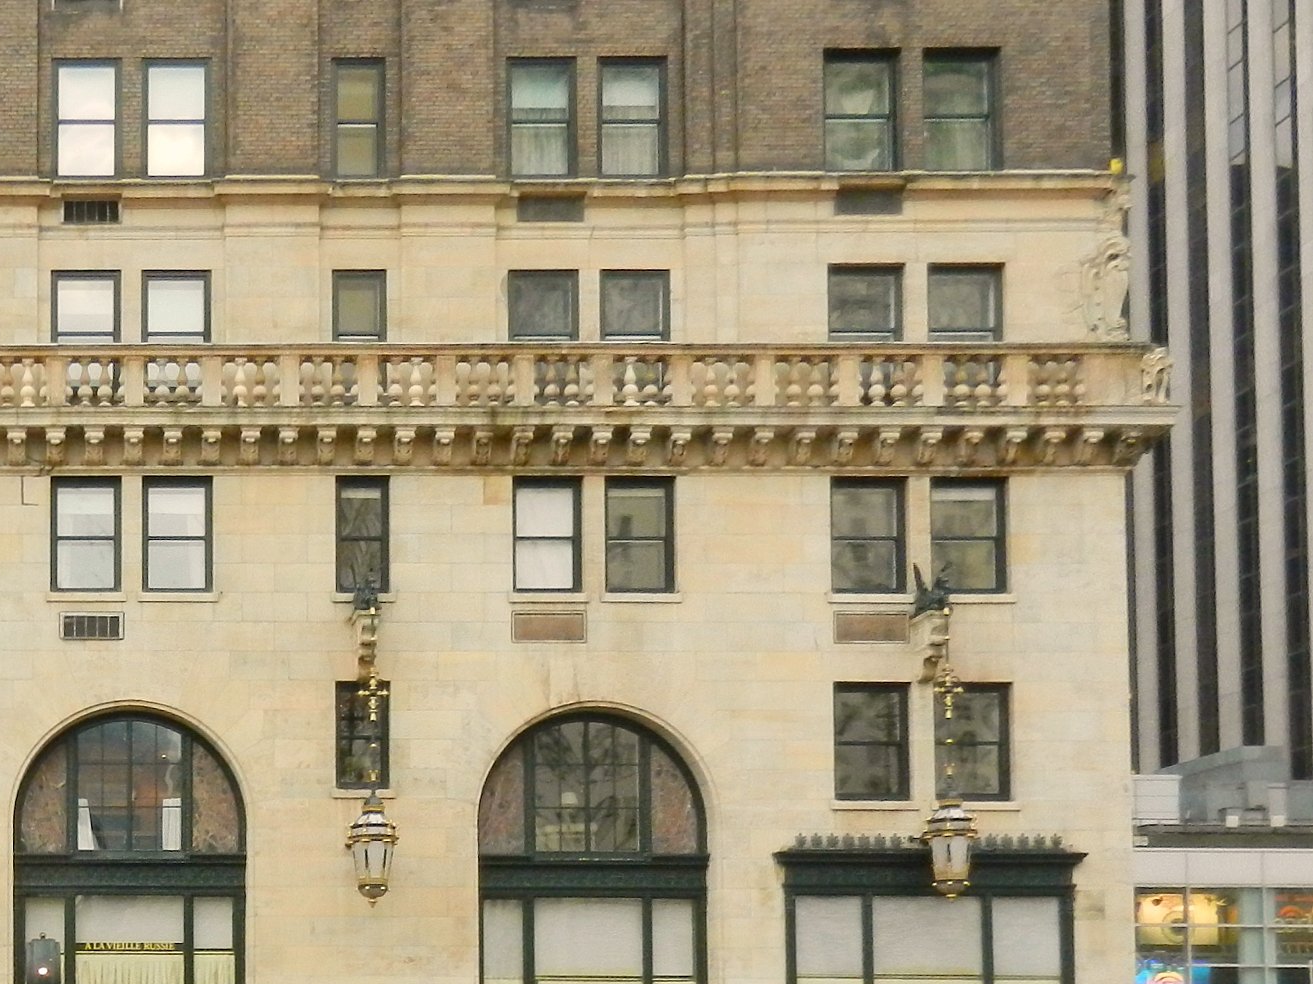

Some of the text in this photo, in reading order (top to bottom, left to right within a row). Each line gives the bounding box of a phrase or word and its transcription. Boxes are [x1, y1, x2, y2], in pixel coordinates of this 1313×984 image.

[84, 942, 176, 950] A LA VIEILLE RUSSIE
